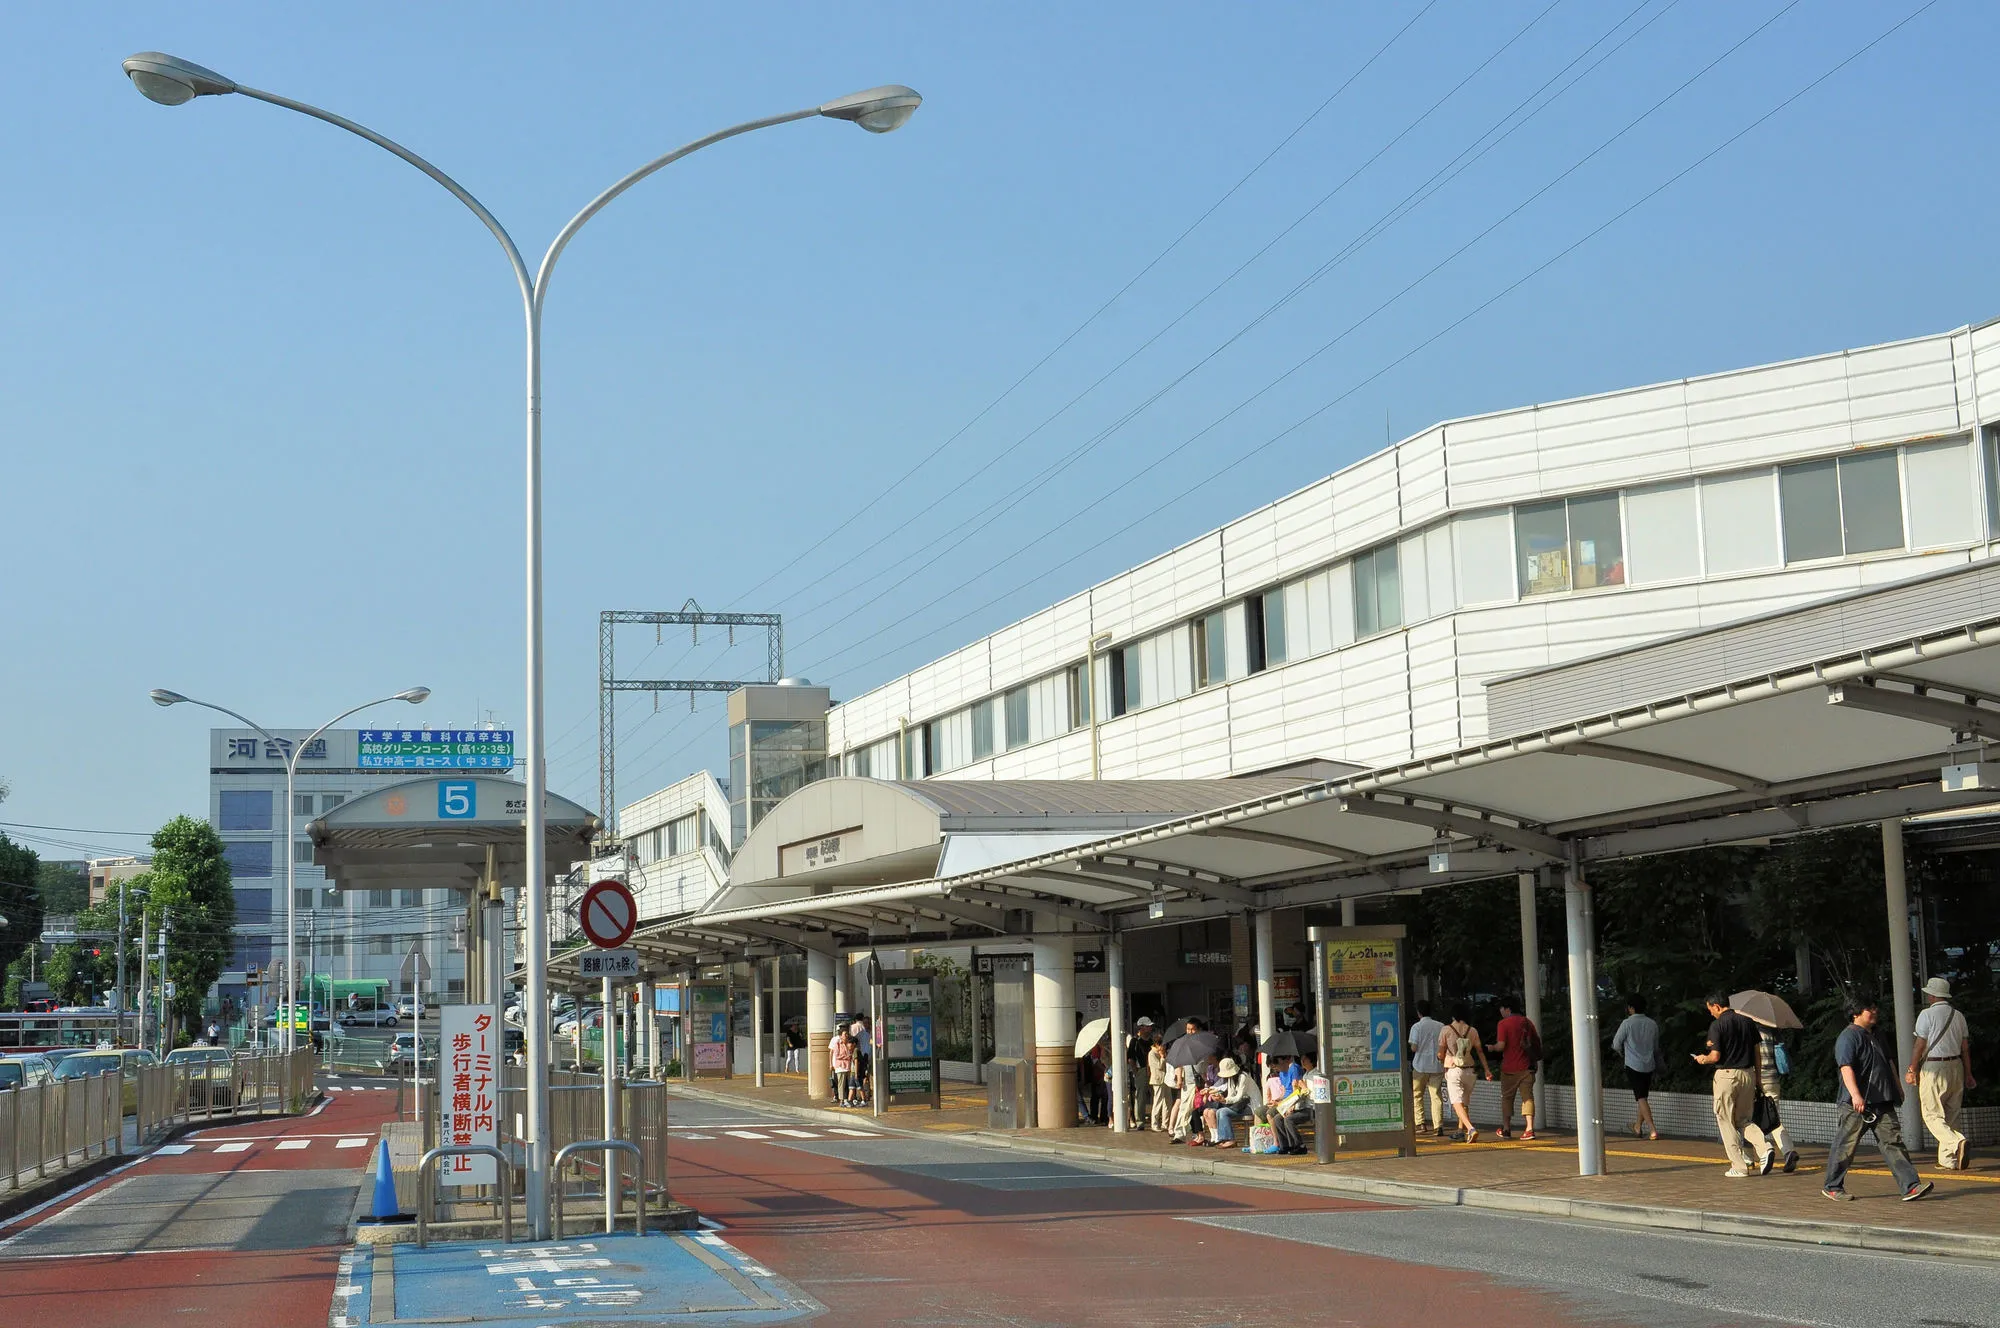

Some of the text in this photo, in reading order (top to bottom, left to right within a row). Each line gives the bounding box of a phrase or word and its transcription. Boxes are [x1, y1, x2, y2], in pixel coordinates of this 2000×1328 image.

[228, 737, 327, 760] 河合塾
[445, 785, 469, 815] 5
[583, 956, 636, 972] 路線バスを除く
[713, 1019, 723, 1039] 4
[915, 1026, 928, 1052] 3
[1375, 1020, 1395, 1062] 2
[474, 1013, 493, 1132] ターミナル内
[442, 1113, 451, 1176] 東急バス式会社
